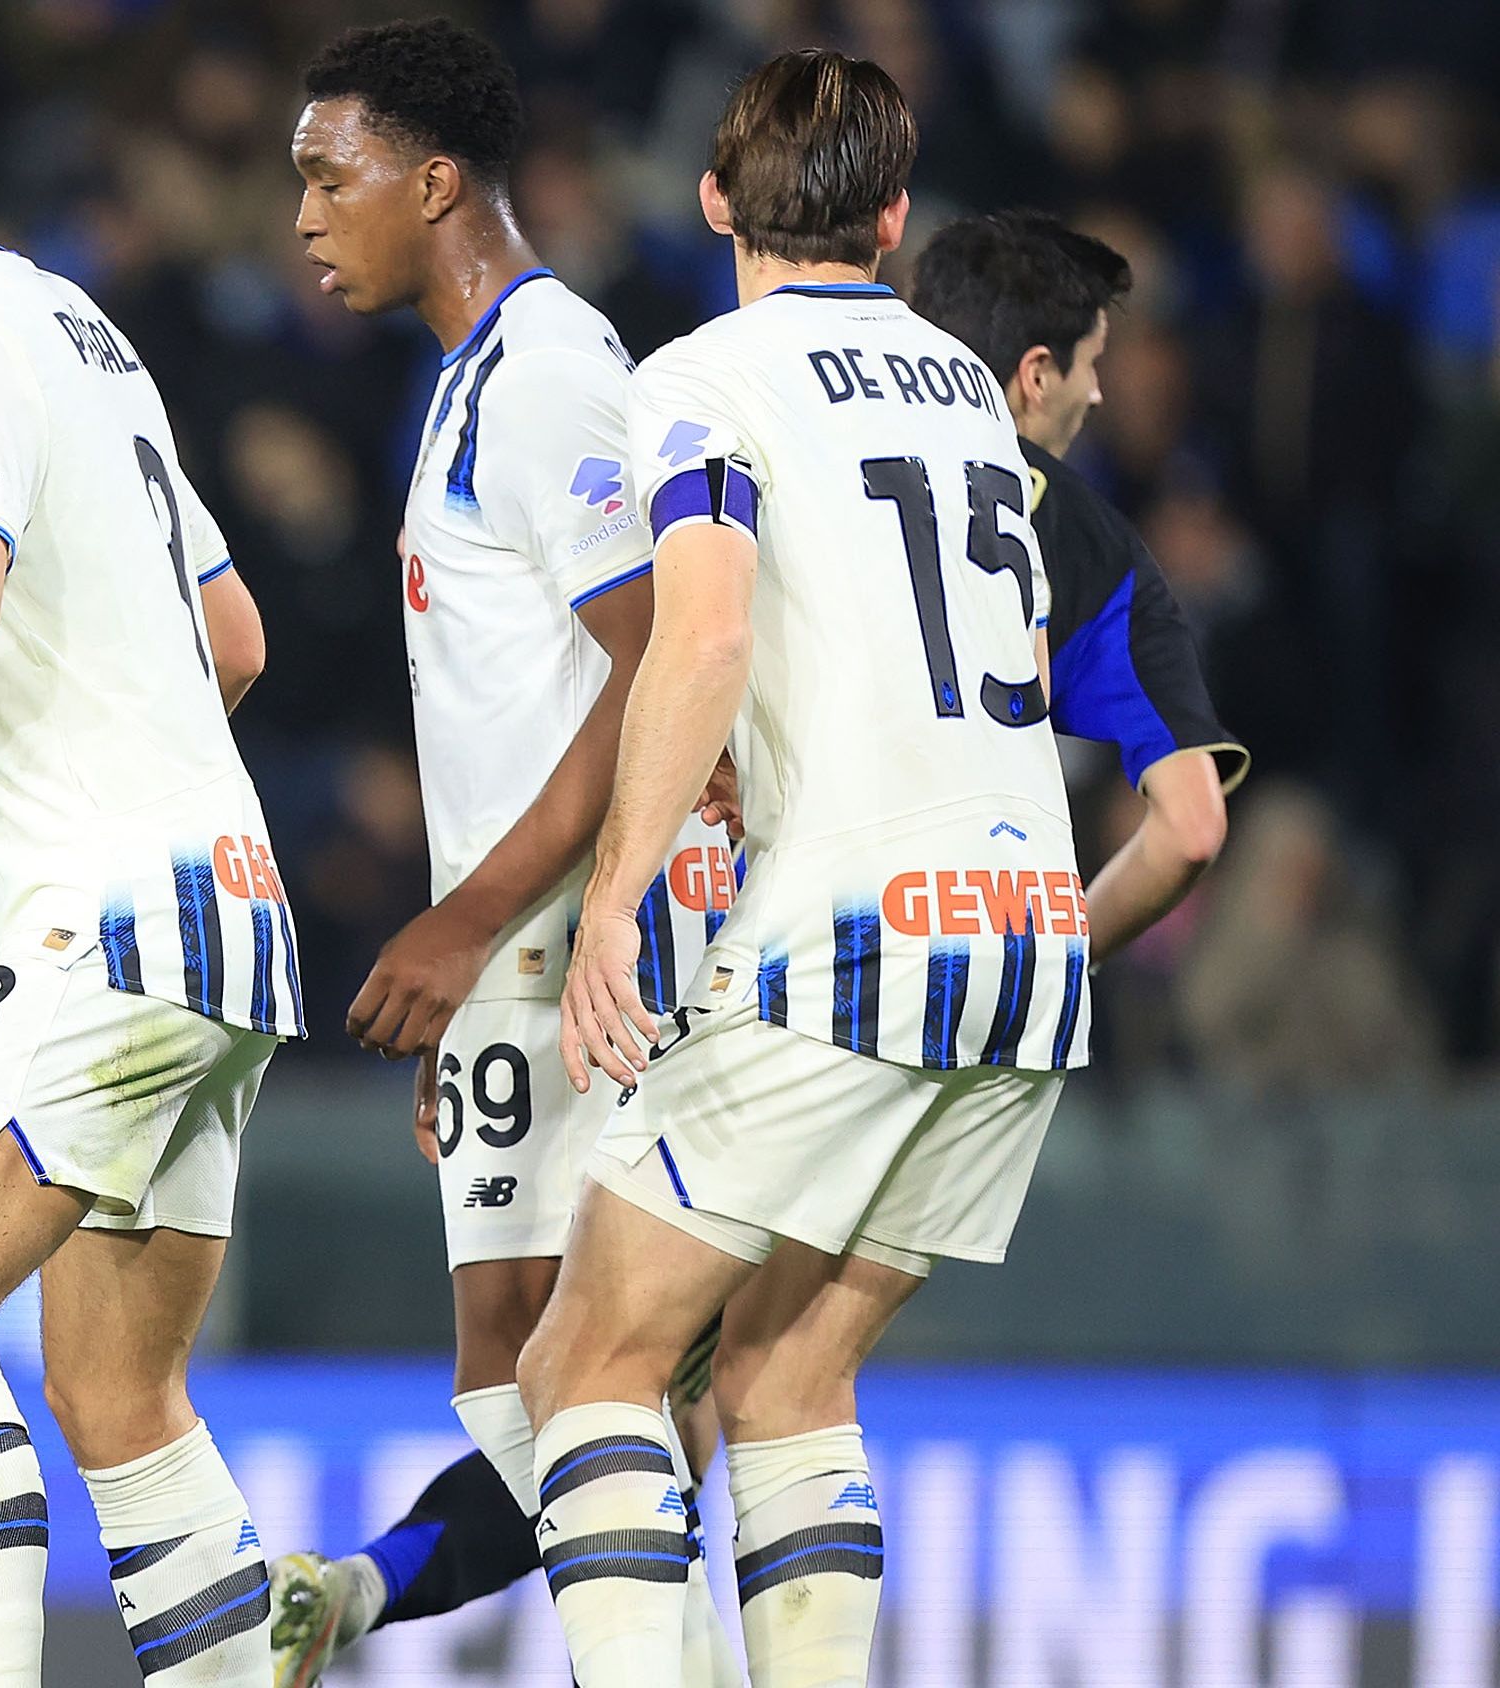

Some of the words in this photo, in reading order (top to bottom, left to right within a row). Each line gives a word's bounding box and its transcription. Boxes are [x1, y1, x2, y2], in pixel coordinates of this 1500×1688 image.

[807, 348, 884, 404] DE
[883, 352, 1001, 422] ROON
[860, 456, 1048, 729] 15
[434, 1043, 532, 1158] 69
